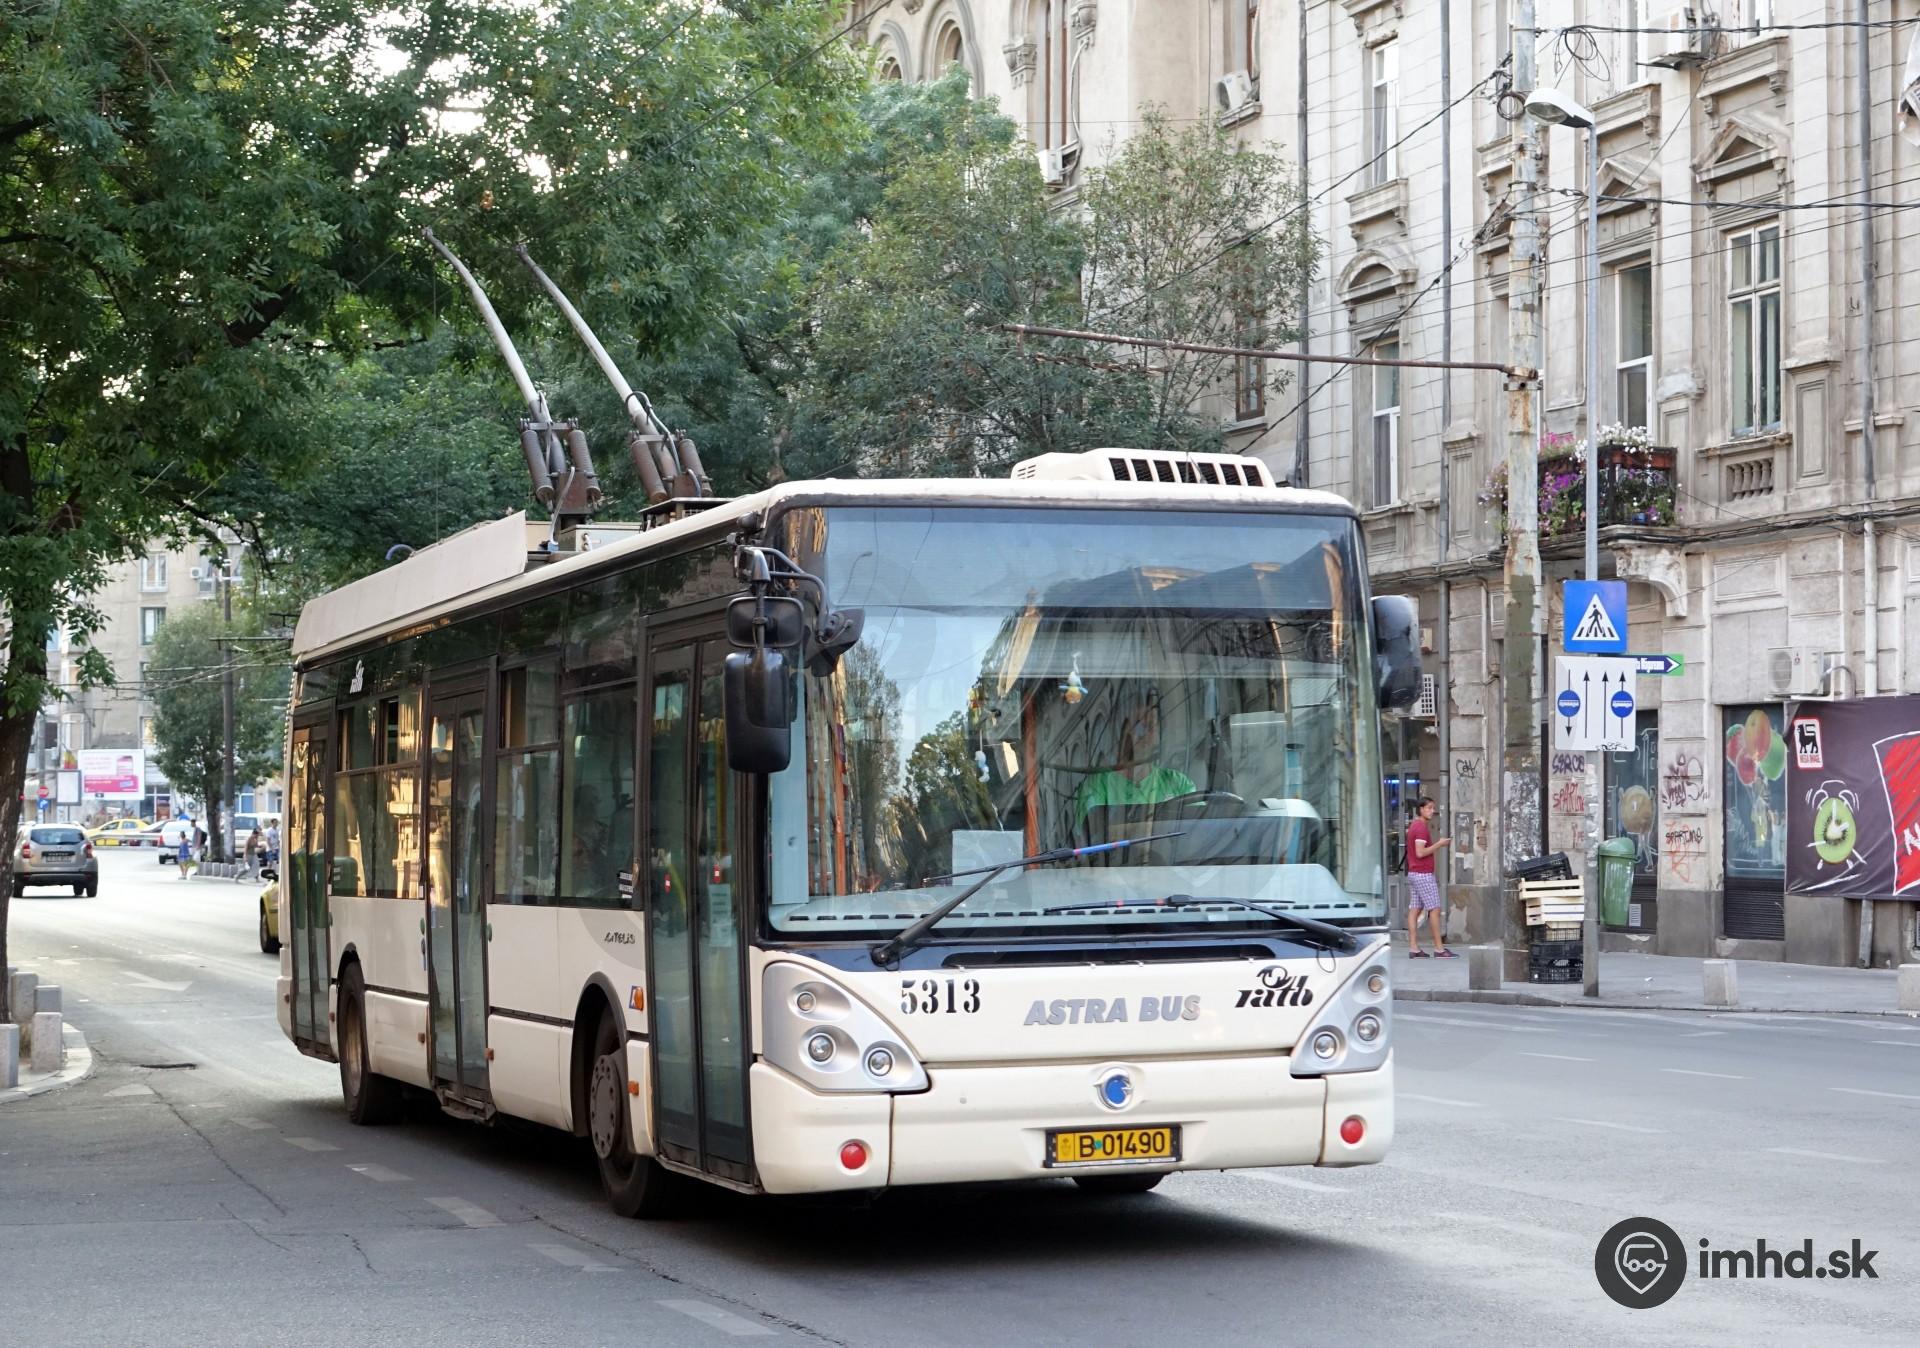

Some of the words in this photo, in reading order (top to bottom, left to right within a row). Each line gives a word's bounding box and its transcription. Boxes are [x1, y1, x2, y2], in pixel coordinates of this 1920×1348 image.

[901, 979, 981, 1015] 5313
[1023, 997, 1129, 1026] ASTRA
[1139, 994, 1201, 1022] BUS
[1079, 1134, 1095, 1158] B
[1102, 1130, 1166, 1157] 01490
